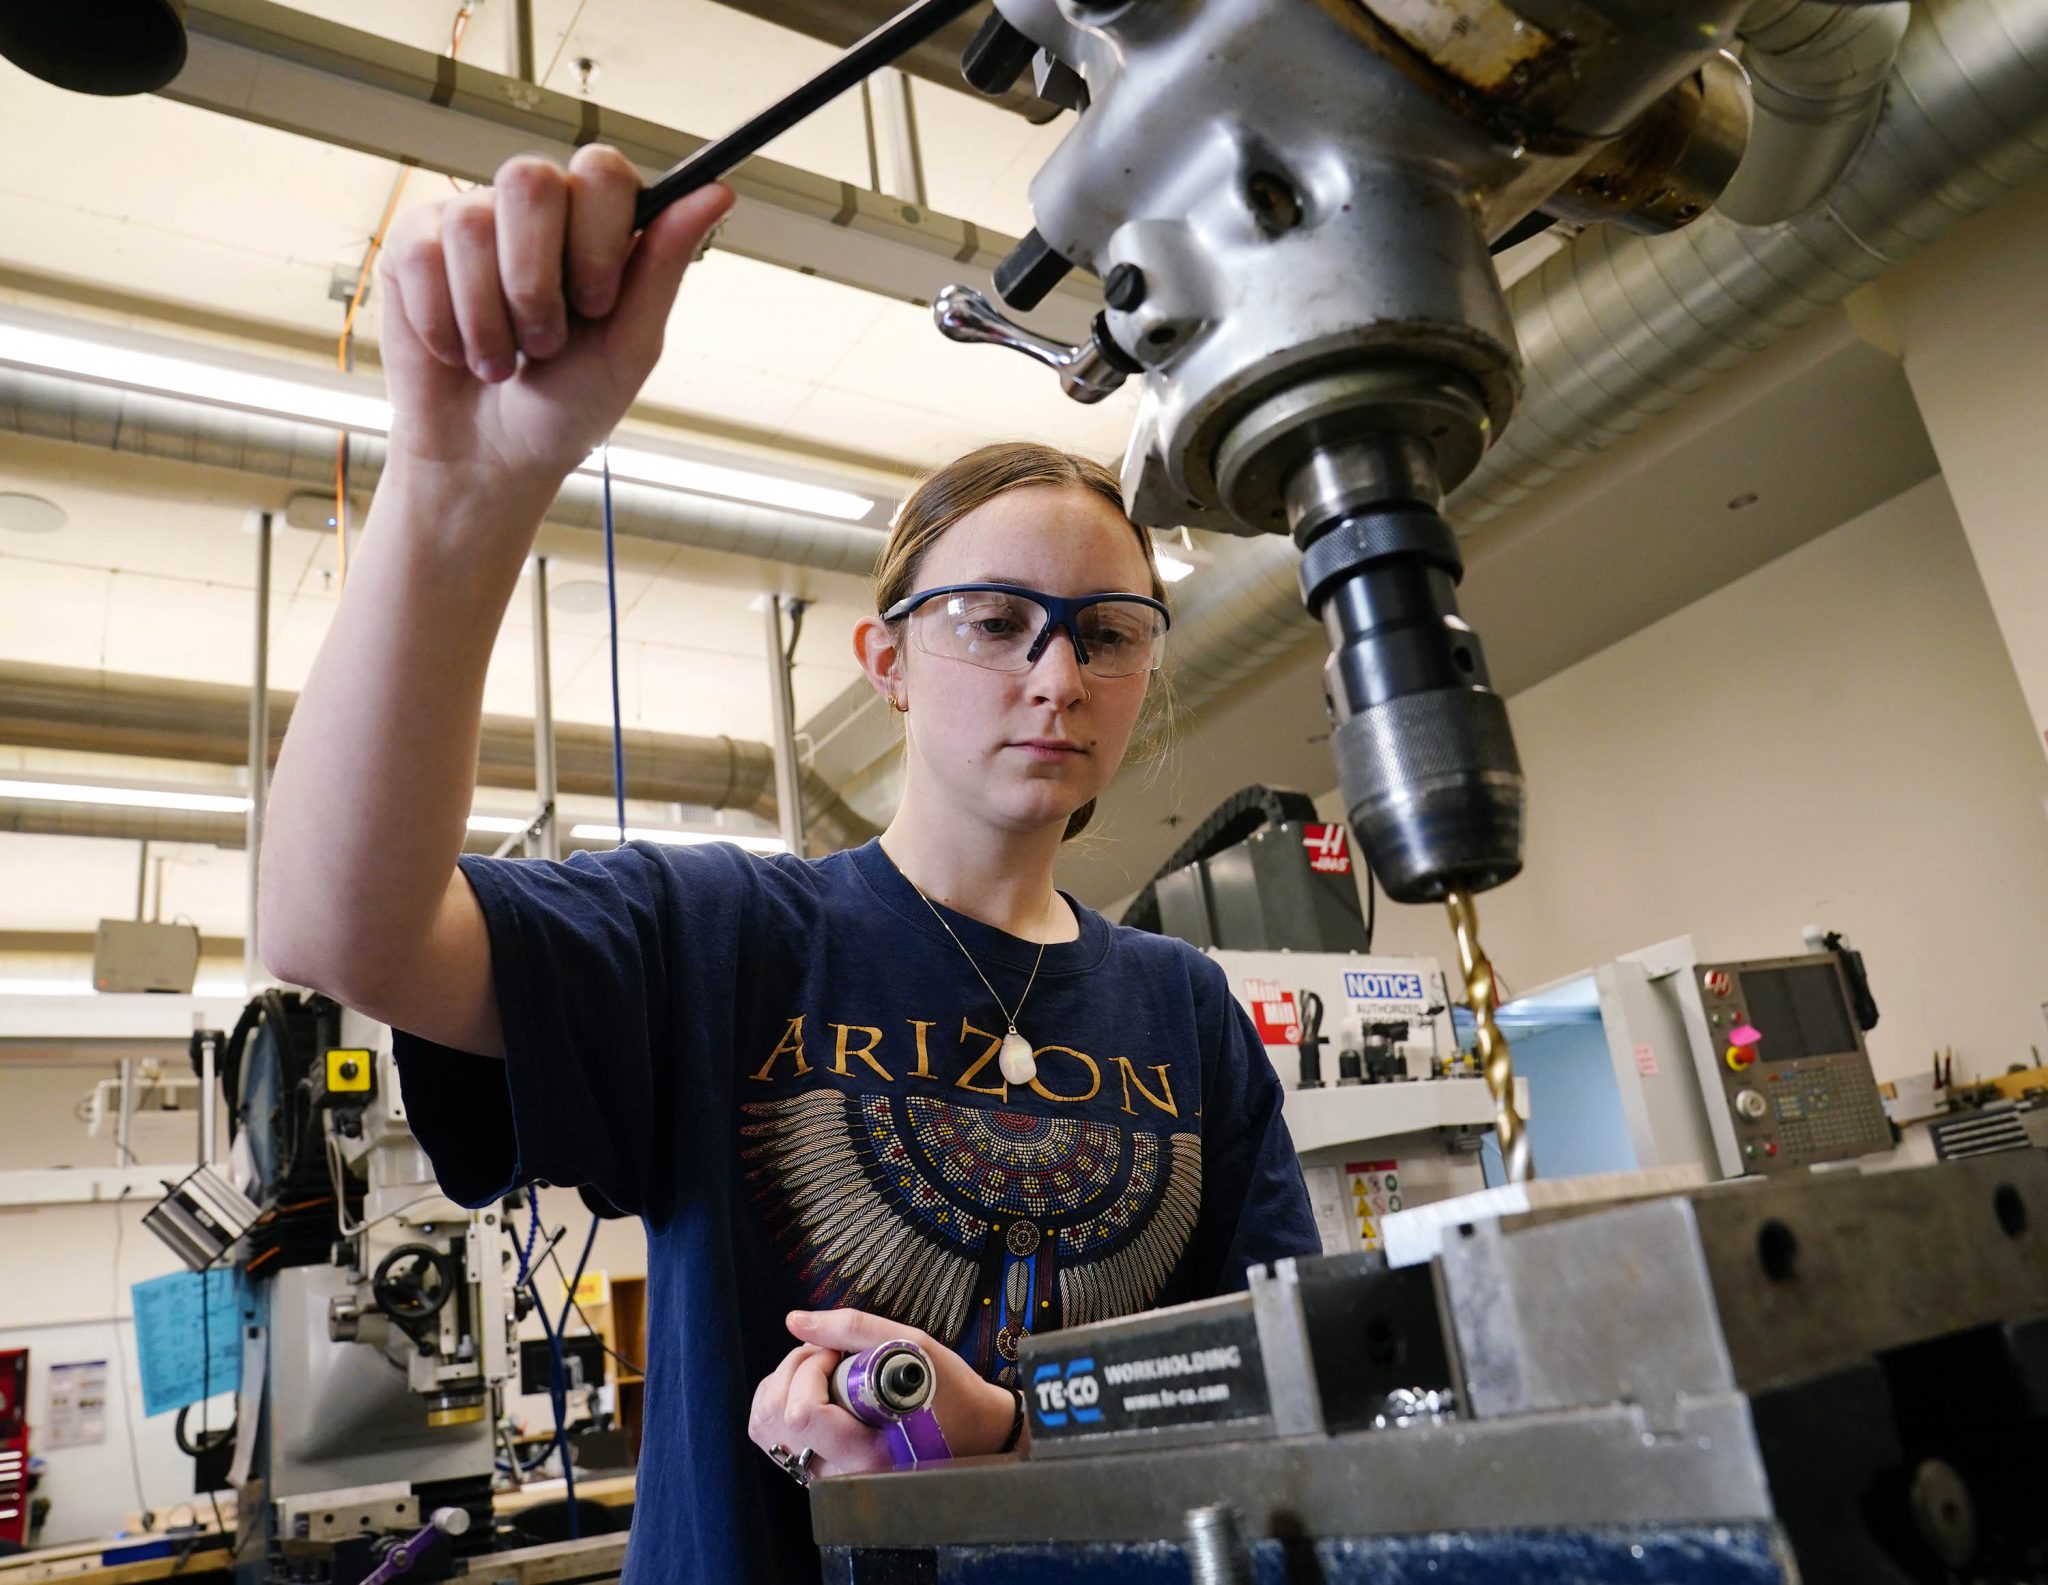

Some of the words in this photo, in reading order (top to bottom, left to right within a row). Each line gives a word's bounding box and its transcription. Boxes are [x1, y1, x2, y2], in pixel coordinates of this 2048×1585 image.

[1346, 974, 1422, 997] NOTICE
[748, 1014, 1202, 1119] ARIZON
[1103, 1345, 1242, 1386] WORKHOLDING
[1122, 1383, 1231, 1412] www.te-co.com
